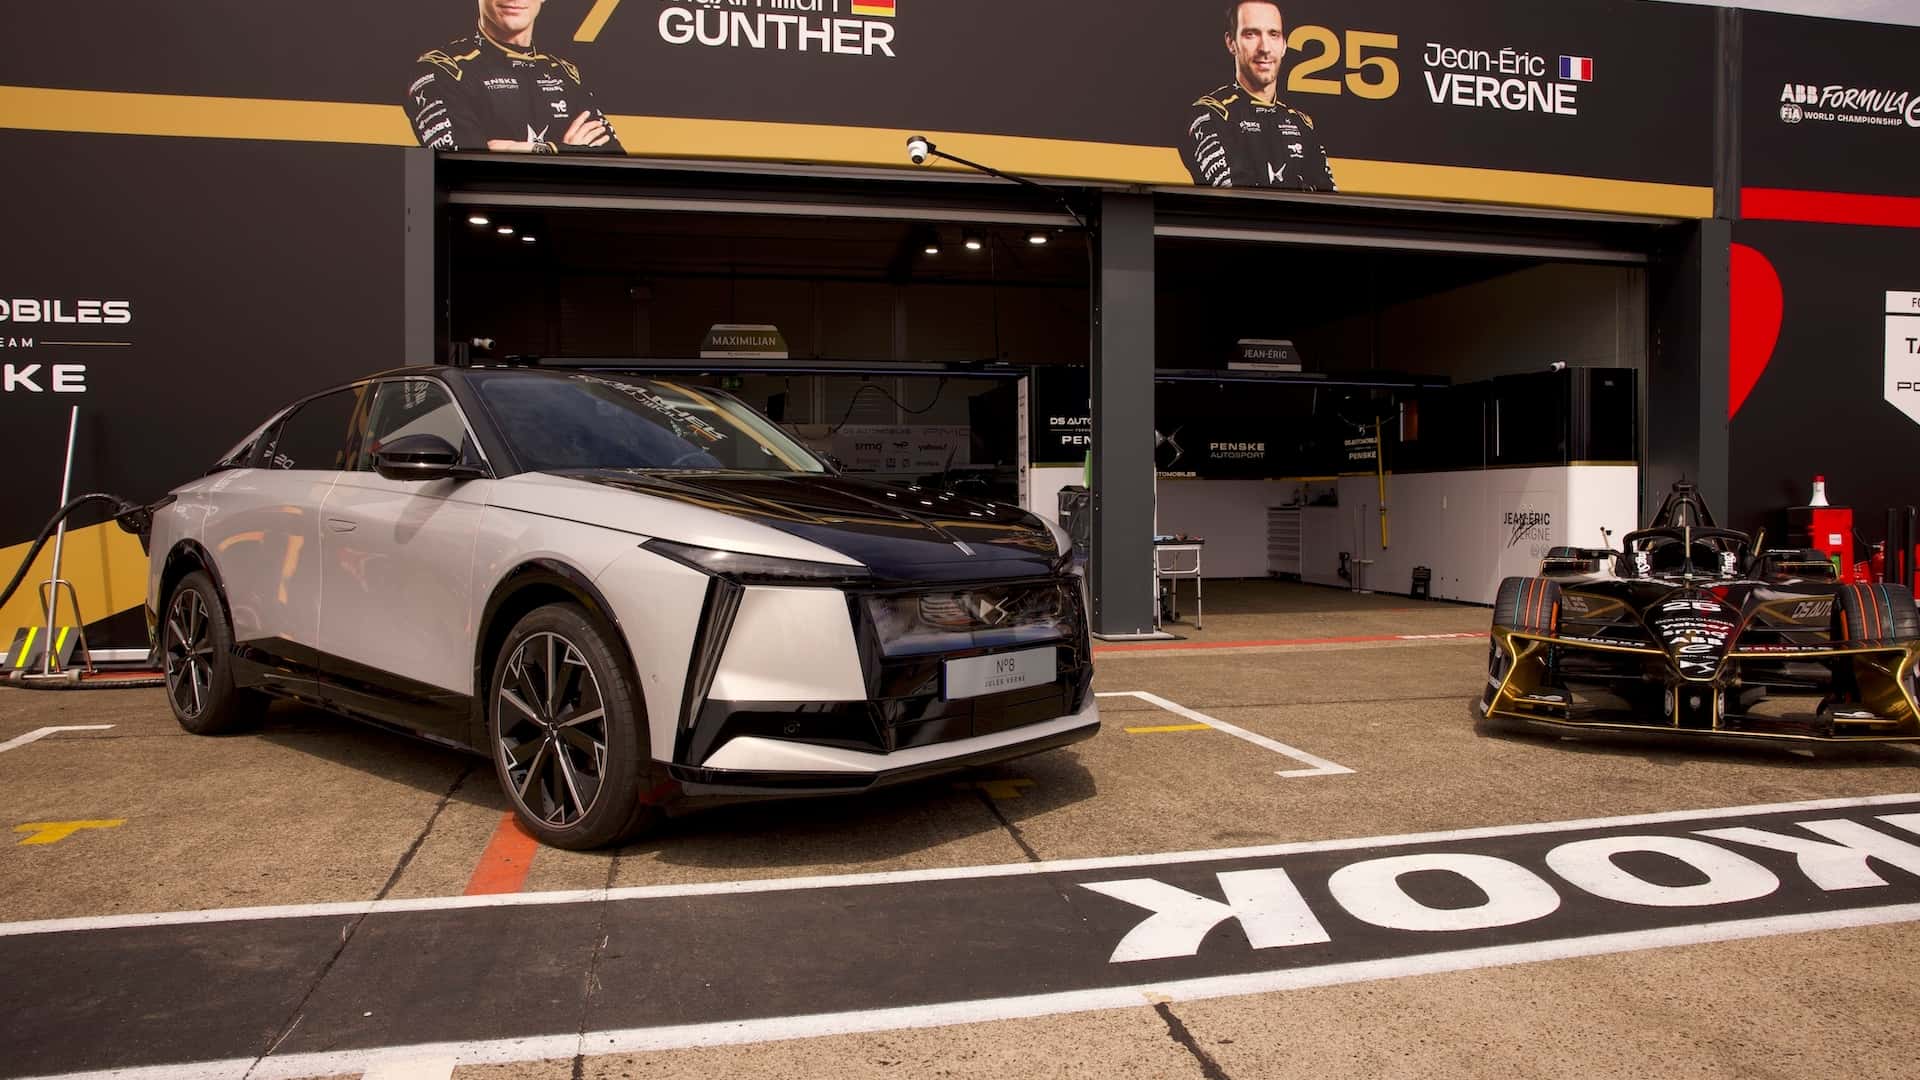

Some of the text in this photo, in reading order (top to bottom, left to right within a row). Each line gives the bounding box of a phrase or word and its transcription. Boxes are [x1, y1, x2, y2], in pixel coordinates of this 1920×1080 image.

[658, 5, 896, 57] GÜNTHER
[1287, 25, 1400, 100] 25
[1423, 43, 1546, 77] Jean-Éric
[1424, 71, 1577, 115] VERGNE
[1781, 83, 1818, 104] ABB
[1819, 85, 1909, 114] FORMULA
[1804, 111, 1835, 121] WORLD
[1837, 114, 1903, 126] CHAMPIONSHIP
[712, 336, 776, 346] MAXIMILIAN
[1905, 337, 1920, 354] T
[1049, 417, 1066, 425] DS
[1210, 442, 1265, 452] PENSKE
[1078, 813, 1920, 964] KOOK
